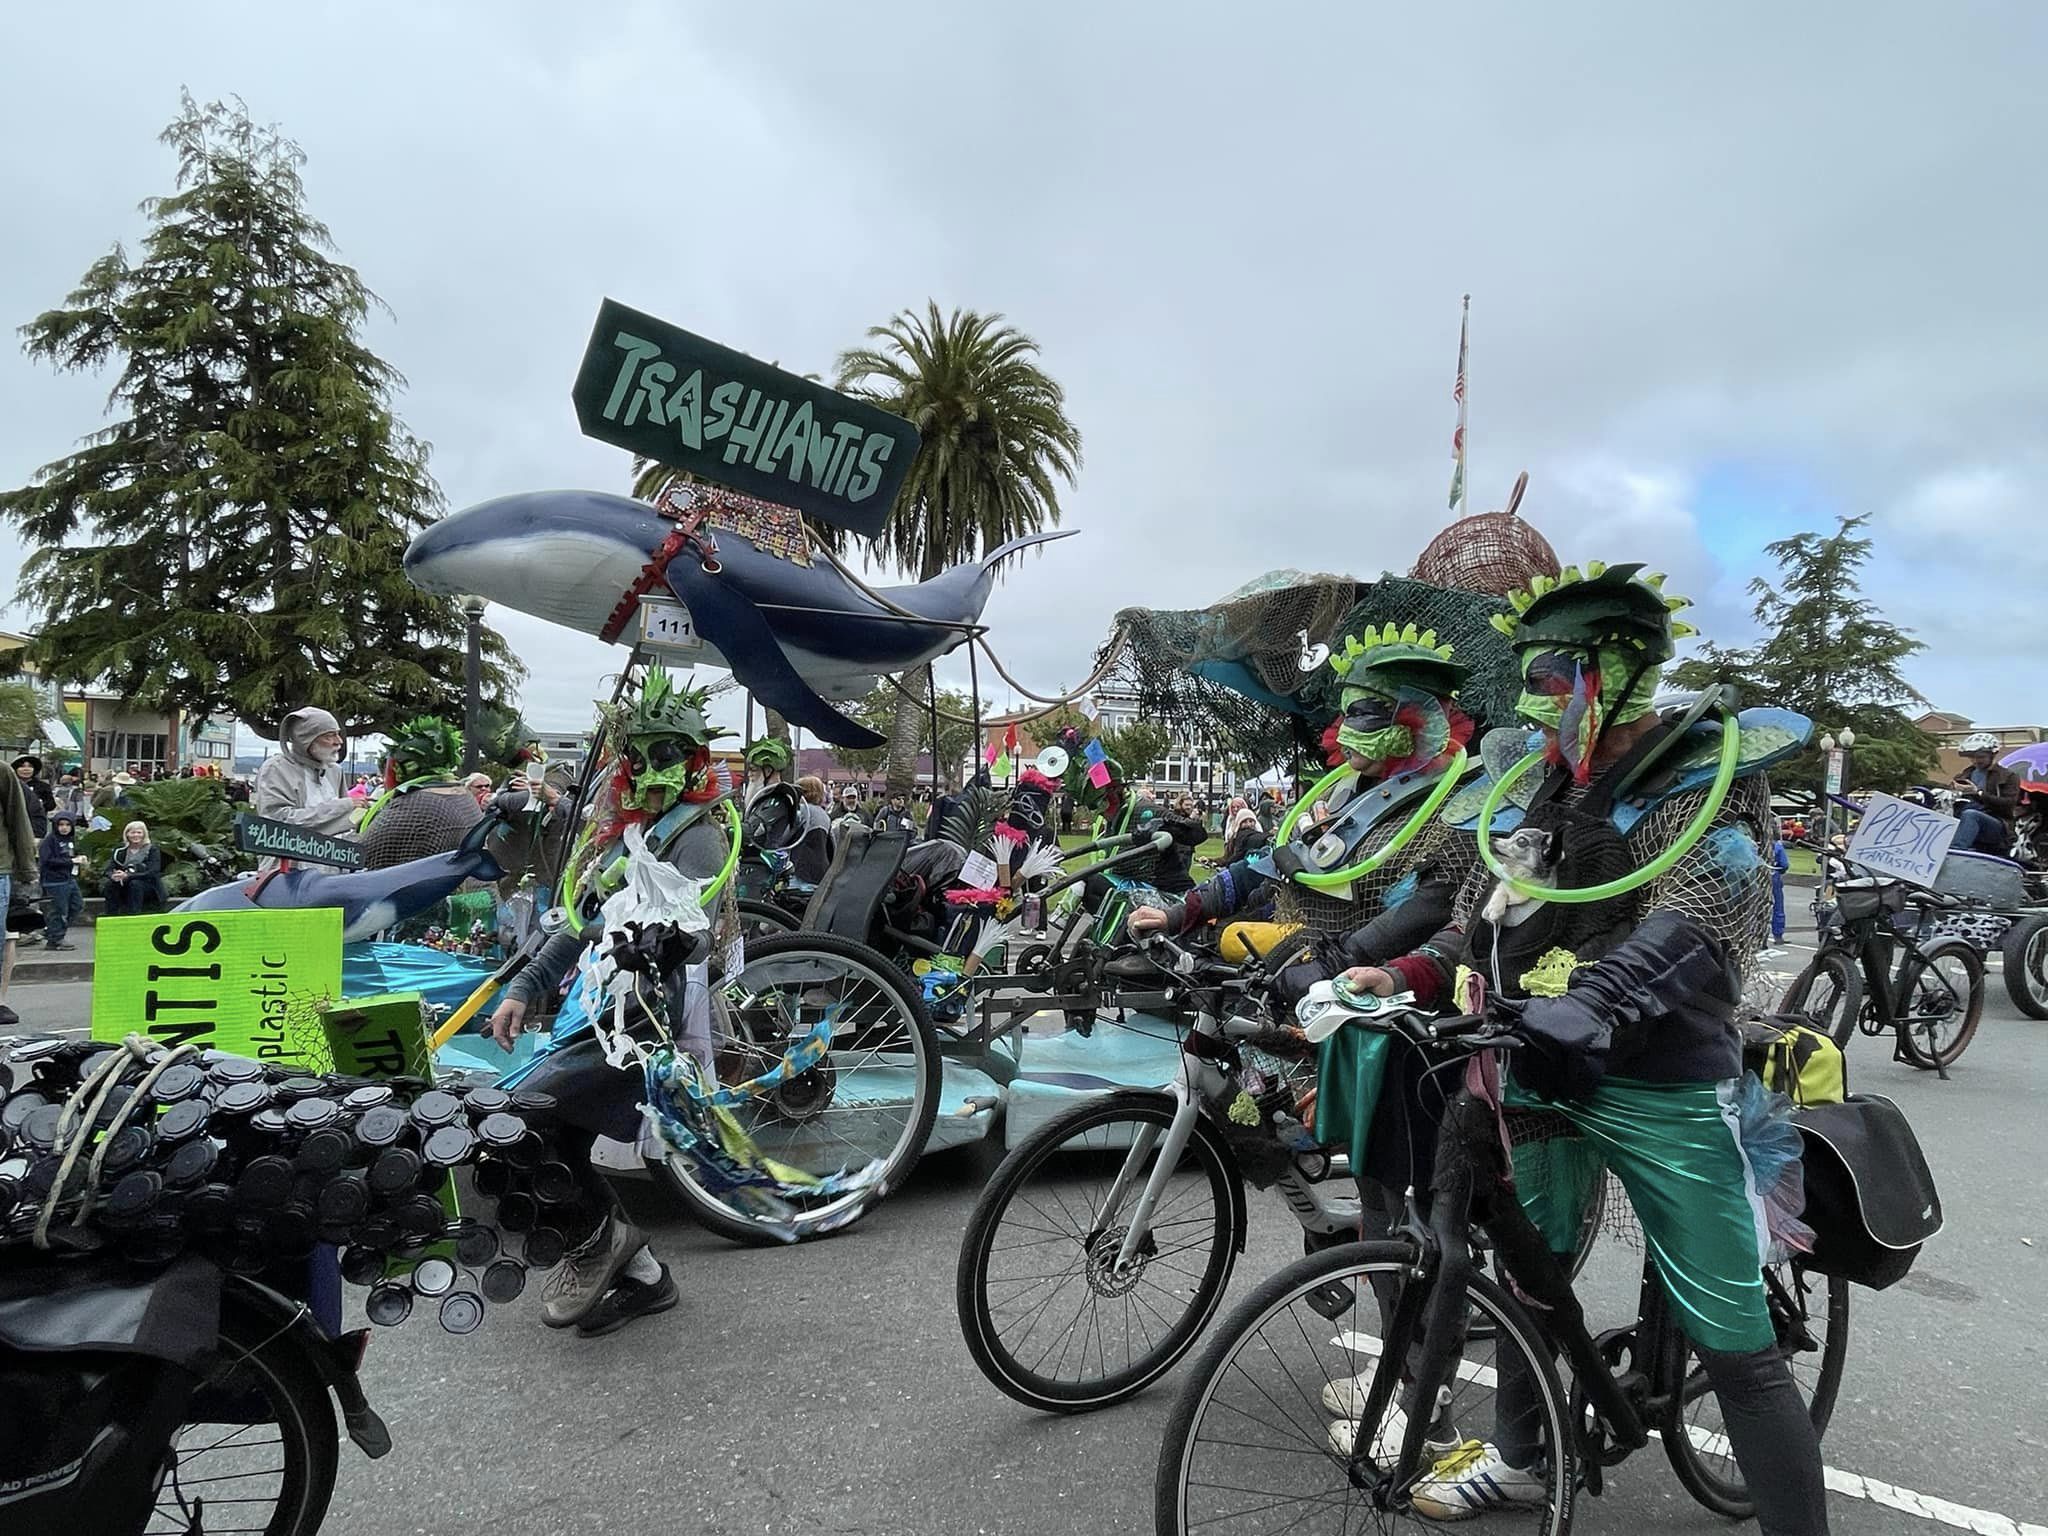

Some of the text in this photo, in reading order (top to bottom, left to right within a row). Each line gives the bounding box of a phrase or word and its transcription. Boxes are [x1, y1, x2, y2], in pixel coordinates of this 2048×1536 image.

[602, 331, 895, 502] TRASHLANTIS
[658, 618, 691, 636] 111
[247, 823, 361, 865] #AddictedtoPlastic
[1861, 803, 1955, 862] PLASTIC
[1856, 848, 1935, 879] FANTASTIC!
[0, 1480, 22, 1493] AD
